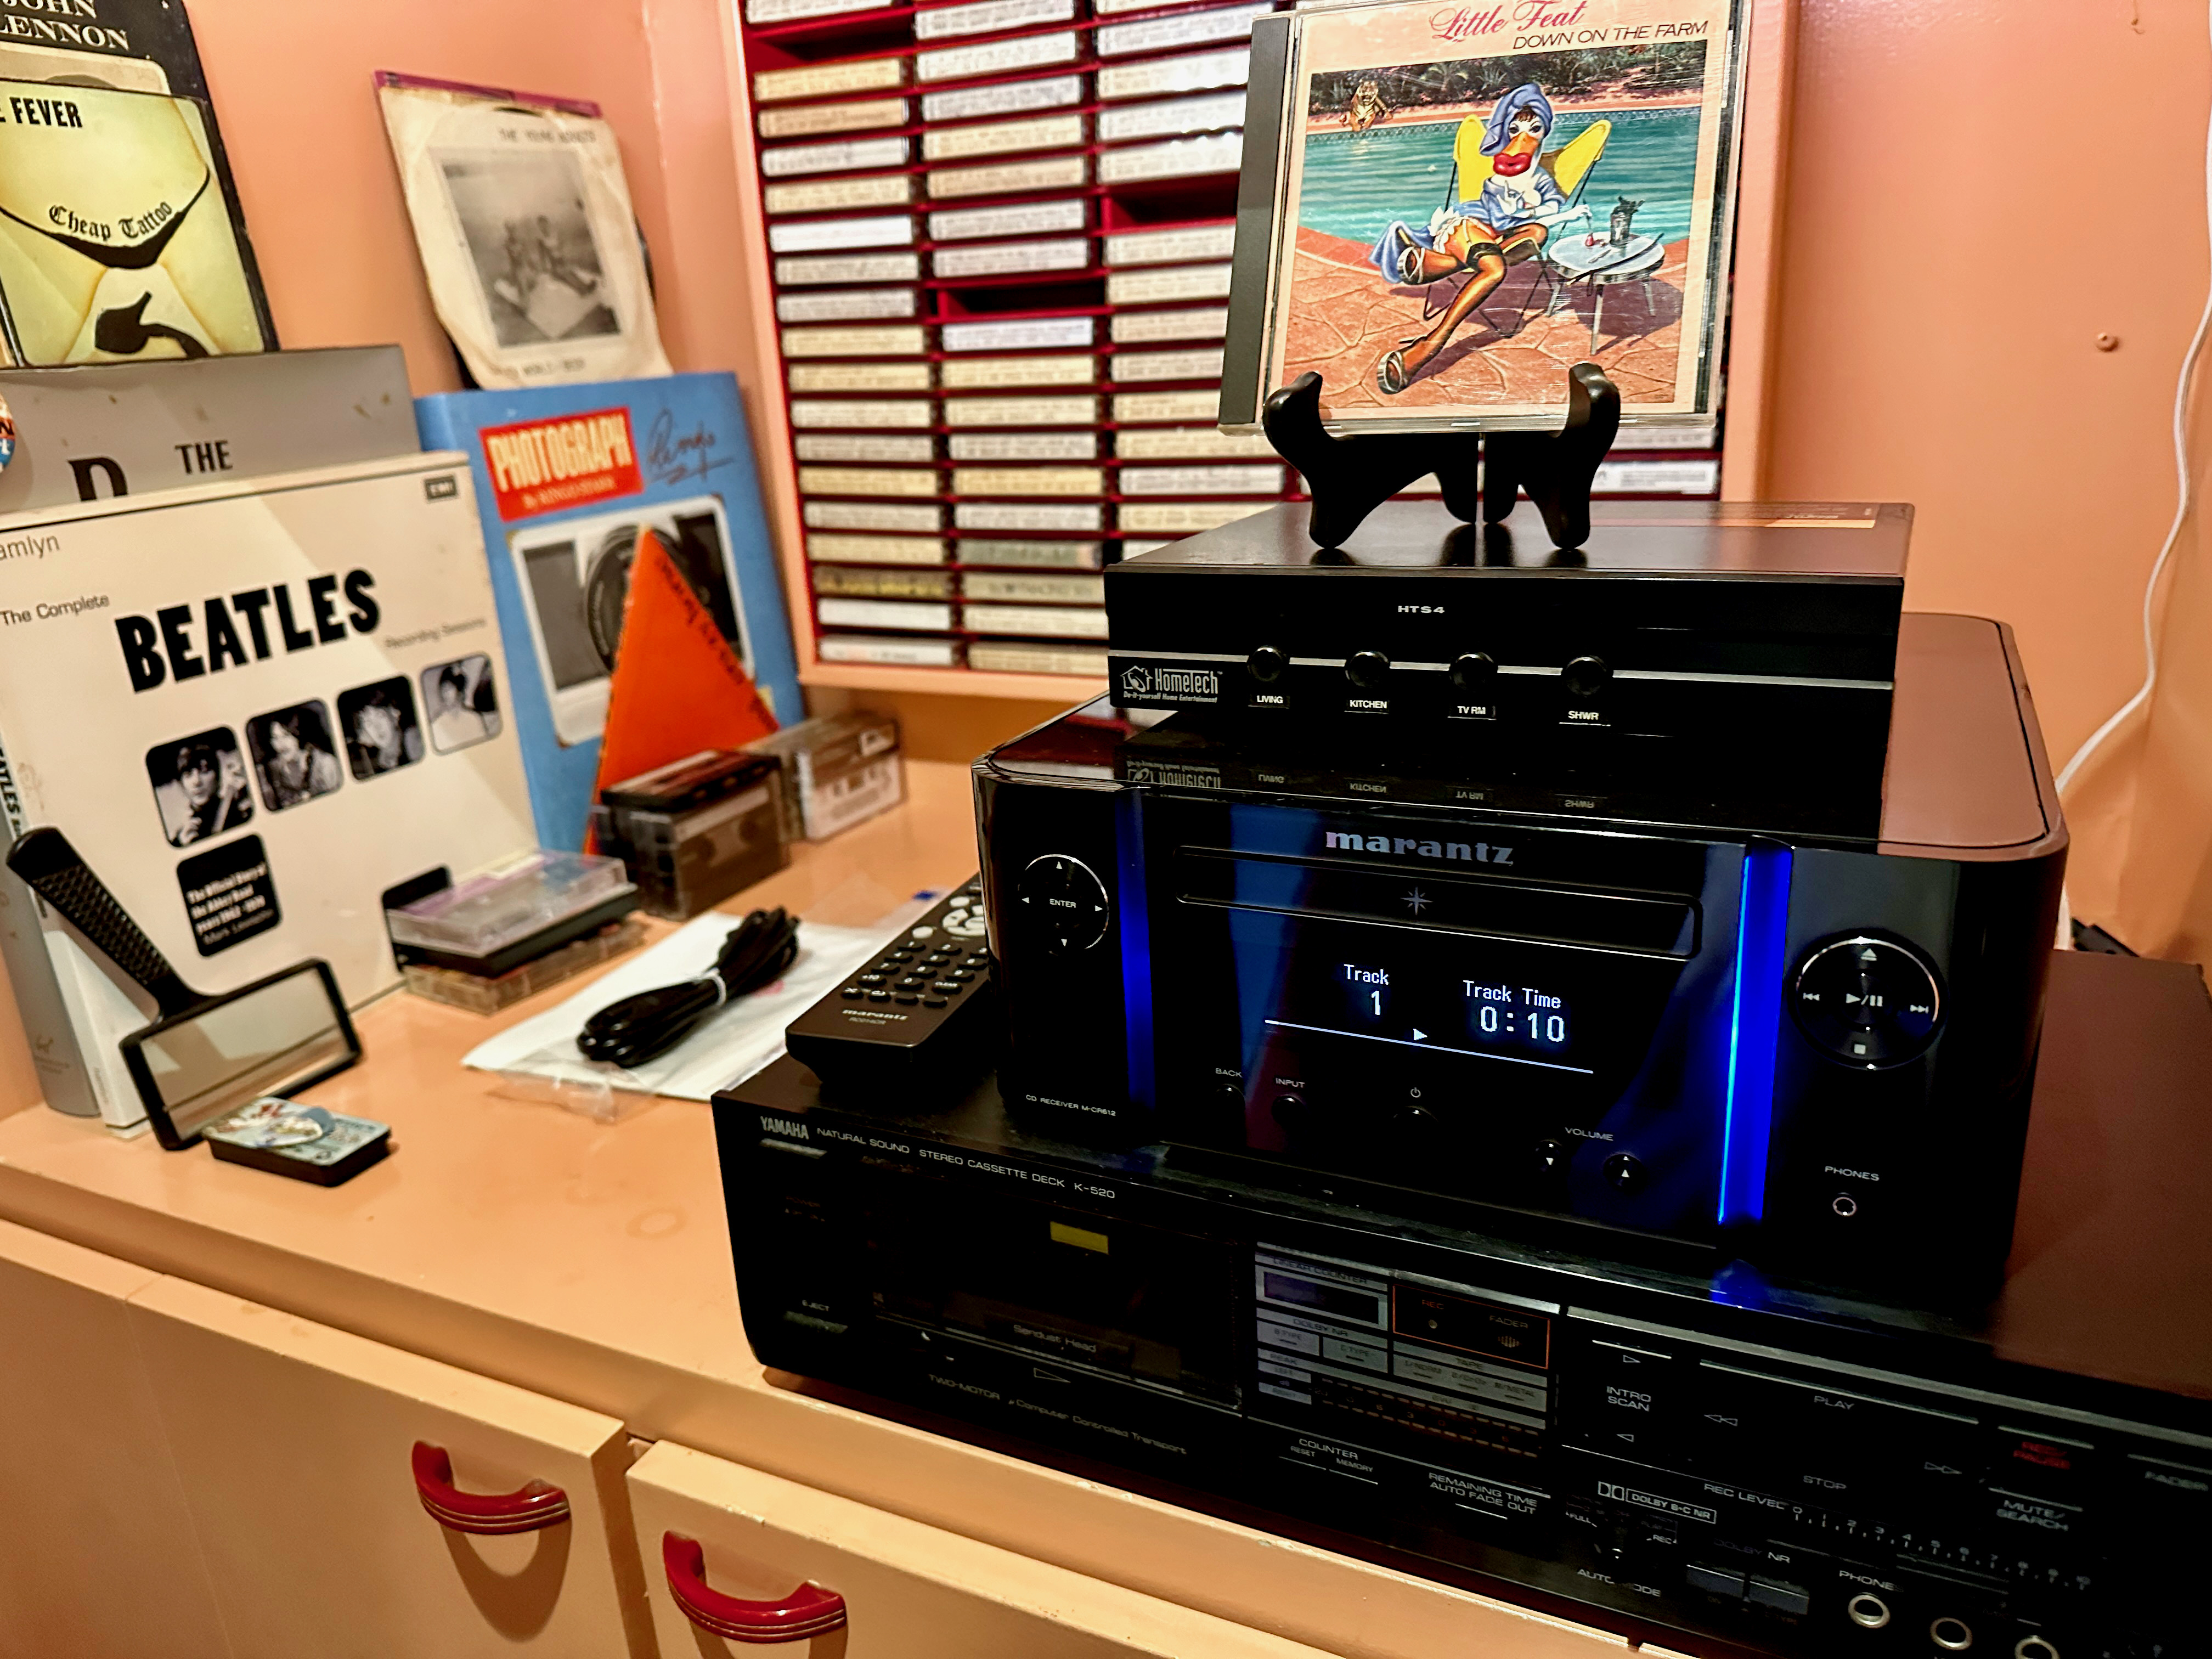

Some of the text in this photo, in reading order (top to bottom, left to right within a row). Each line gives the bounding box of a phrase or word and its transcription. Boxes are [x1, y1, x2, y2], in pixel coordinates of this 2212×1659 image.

[1429, 0, 1589, 42] Little Feat
[1513, 20, 1709, 50] DOWN ON THE FARM
[9, 97, 83, 128] FEVER
[48, 201, 173, 241] Cheap Tattoo
[175, 440, 233, 475] THE
[487, 413, 633, 493] PHOTOGRAPH
[0, 535, 60, 561] amlyn
[0, 595, 110, 627] The Complete
[1397, 605, 1446, 614] HTS4
[115, 568, 381, 693] BEATLES
[1155, 668, 1218, 695] HomeTech
[1256, 695, 1284, 704] LIVING
[1349, 699, 1387, 709] KITCHEN
[1457, 705, 1486, 715] TV RM
[1567, 710, 1599, 720] SHWR
[1325, 831, 1514, 867] marantz
[1049, 898, 1077, 909] ENTER
[1344, 963, 1390, 986] Track
[1371, 990, 1381, 1016] 1
[1463, 979, 1561, 1009] Track Time
[842, 1009, 909, 1021] marantz
[1480, 1006, 1565, 1043] 0:10
[1215, 1067, 1243, 1079] BACK
[1276, 1077, 1306, 1089] INPUT
[1040, 1097, 1079, 1109] RECEIVER
[1565, 1126, 1614, 1142] VOLUME
[760, 1115, 1115, 1199] YAMAHA NATURAL SOUND STEREO CASSETTE DECK K-520
[1824, 1165, 1880, 1182] PHONES
[1421, 1299, 1444, 1310] REC
[1489, 1314, 1529, 1329] FADER
[1065, 1338, 1097, 1352] Head
[928, 1373, 1001, 1401] TWO-MOTOR
[1606, 1385, 1652, 1403] INTRO
[1607, 1396, 1650, 1412] SCAN
[1813, 1395, 1855, 1410] PLAY
[1290, 1446, 1316, 1458] RESET
[1299, 1438, 1359, 1460] COUNTER
[1336, 1458, 1373, 1473] MEMORY
[1429, 1472, 1538, 1508] REMAINING TIME
[1803, 1475, 1847, 1491] STOP
[1429, 1482, 1536, 1515] AUTO FADE OUT
[1631, 1493, 1668, 1508] DOLBY
[1693, 1509, 1711, 1519] NR
[1704, 1483, 1786, 1511] REC LEVEL
[1652, 1534, 1673, 1545] REC
[1713, 1537, 1791, 1564] DOLBY NR
